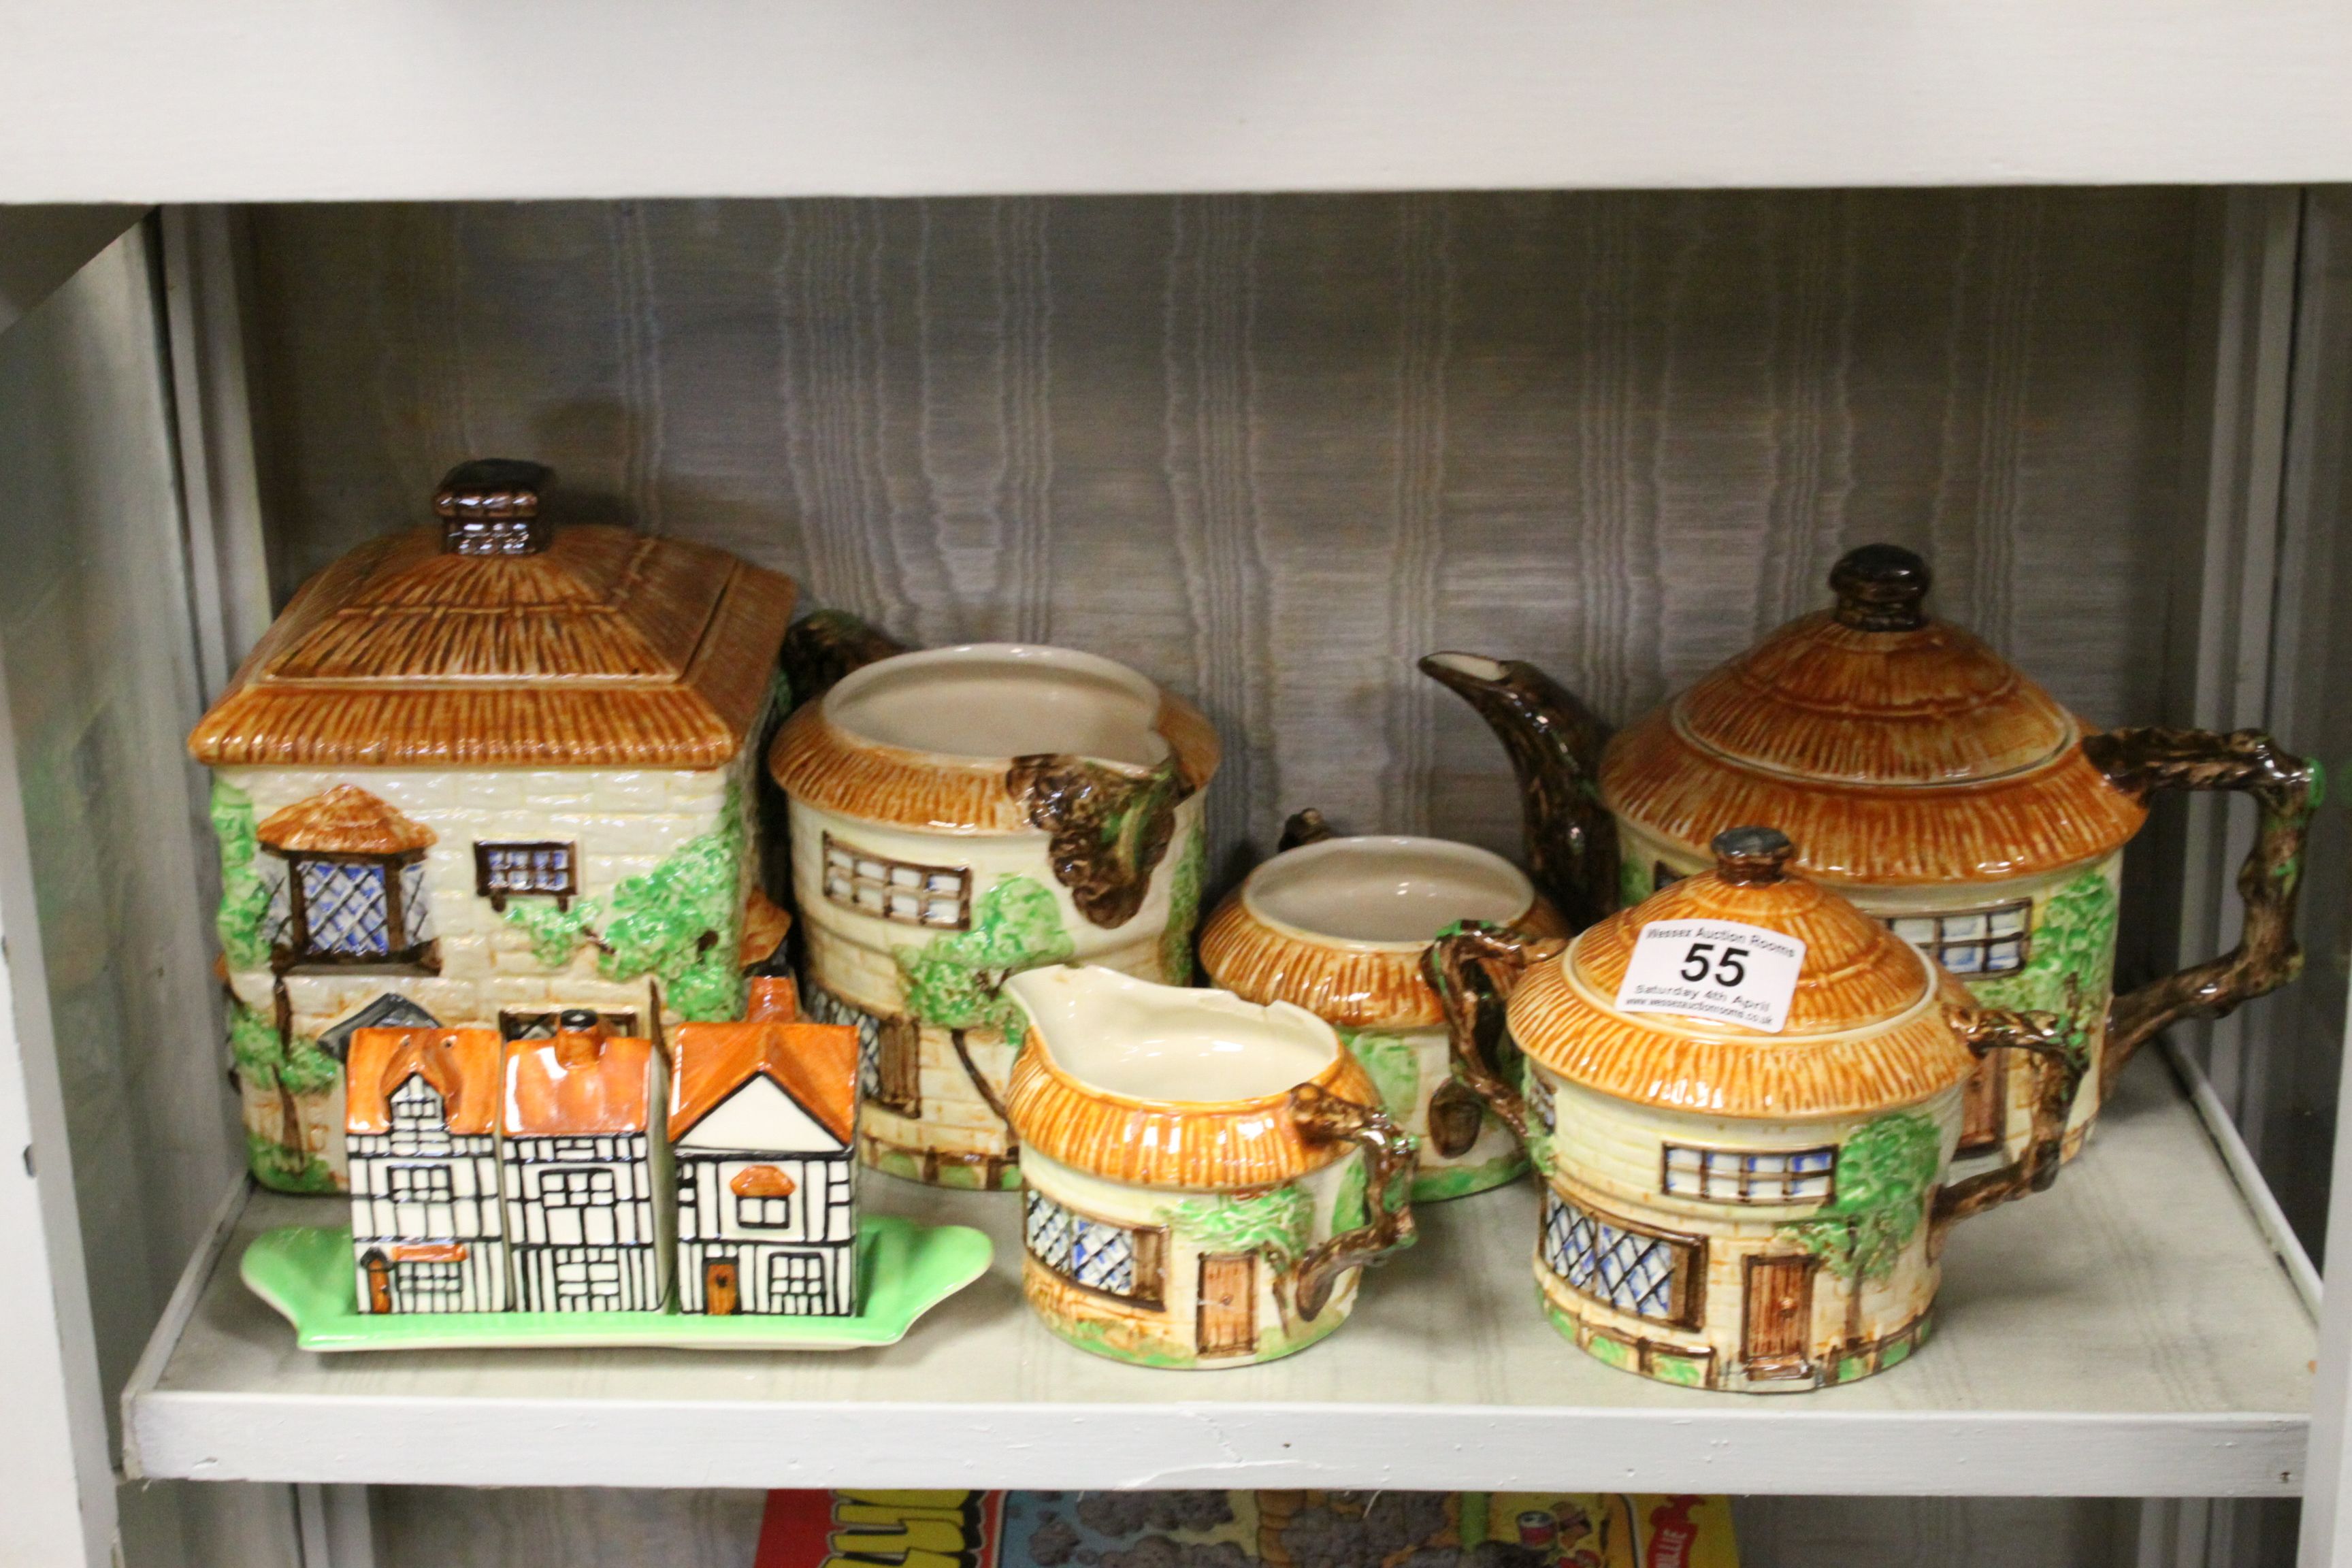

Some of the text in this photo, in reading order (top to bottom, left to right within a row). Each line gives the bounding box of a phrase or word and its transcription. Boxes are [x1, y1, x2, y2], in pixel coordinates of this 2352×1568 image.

[1646, 926, 1795, 958] Wessex Auction Rooms
[1680, 943, 1750, 987] 55
[1635, 984, 1771, 1013] Saturday 4th April
